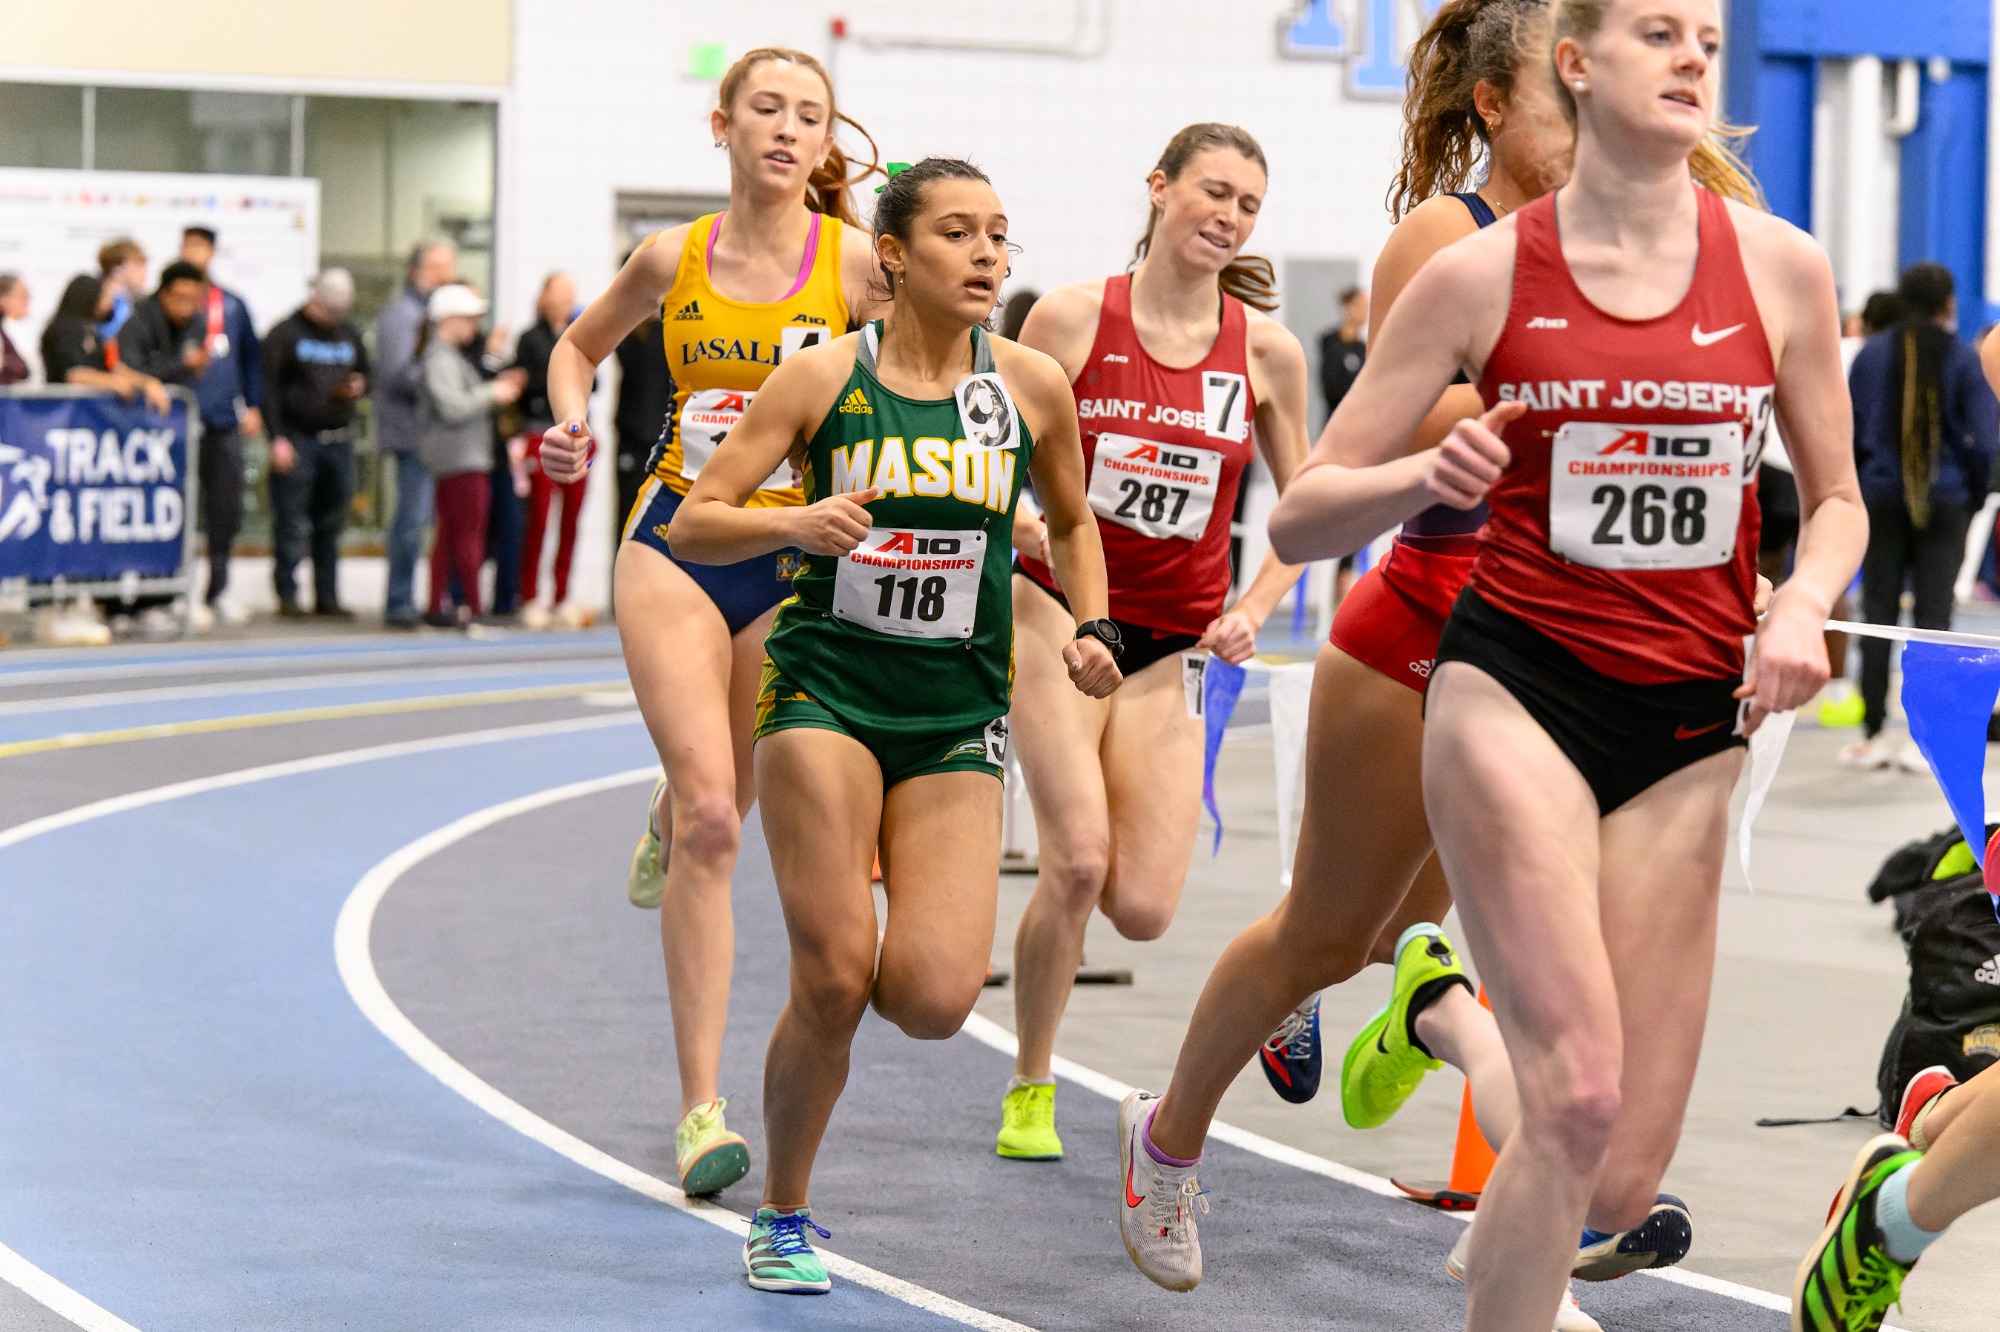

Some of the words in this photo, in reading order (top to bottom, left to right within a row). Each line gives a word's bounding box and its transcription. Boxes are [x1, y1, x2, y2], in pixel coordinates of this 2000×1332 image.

[673, 312, 704, 321] adidas
[791, 313, 827, 325] A10
[838, 403, 873, 415] adidas
[1079, 399, 1146, 420] SAINT
[1209, 377, 1240, 433] 7
[1499, 380, 1605, 411] SAINT
[964, 379, 1011, 447] 9
[46, 427, 177, 485] TRACK
[1123, 441, 1198, 470] A10
[1597, 428, 1710, 457] A10
[831, 436, 1017, 515] MASON
[1103, 457, 1210, 486] CHAMPIONSHIPS
[1568, 461, 1731, 478] CHAMPIONSHIPS
[51, 488, 76, 544] &
[78, 486, 183, 544] FIELD
[1114, 478, 1190, 526] 287
[1591, 484, 1708, 546] 268
[873, 532, 961, 555] A10
[850, 552, 975, 571] CHAMPIONSHIPS
[874, 574, 947, 622] 118
